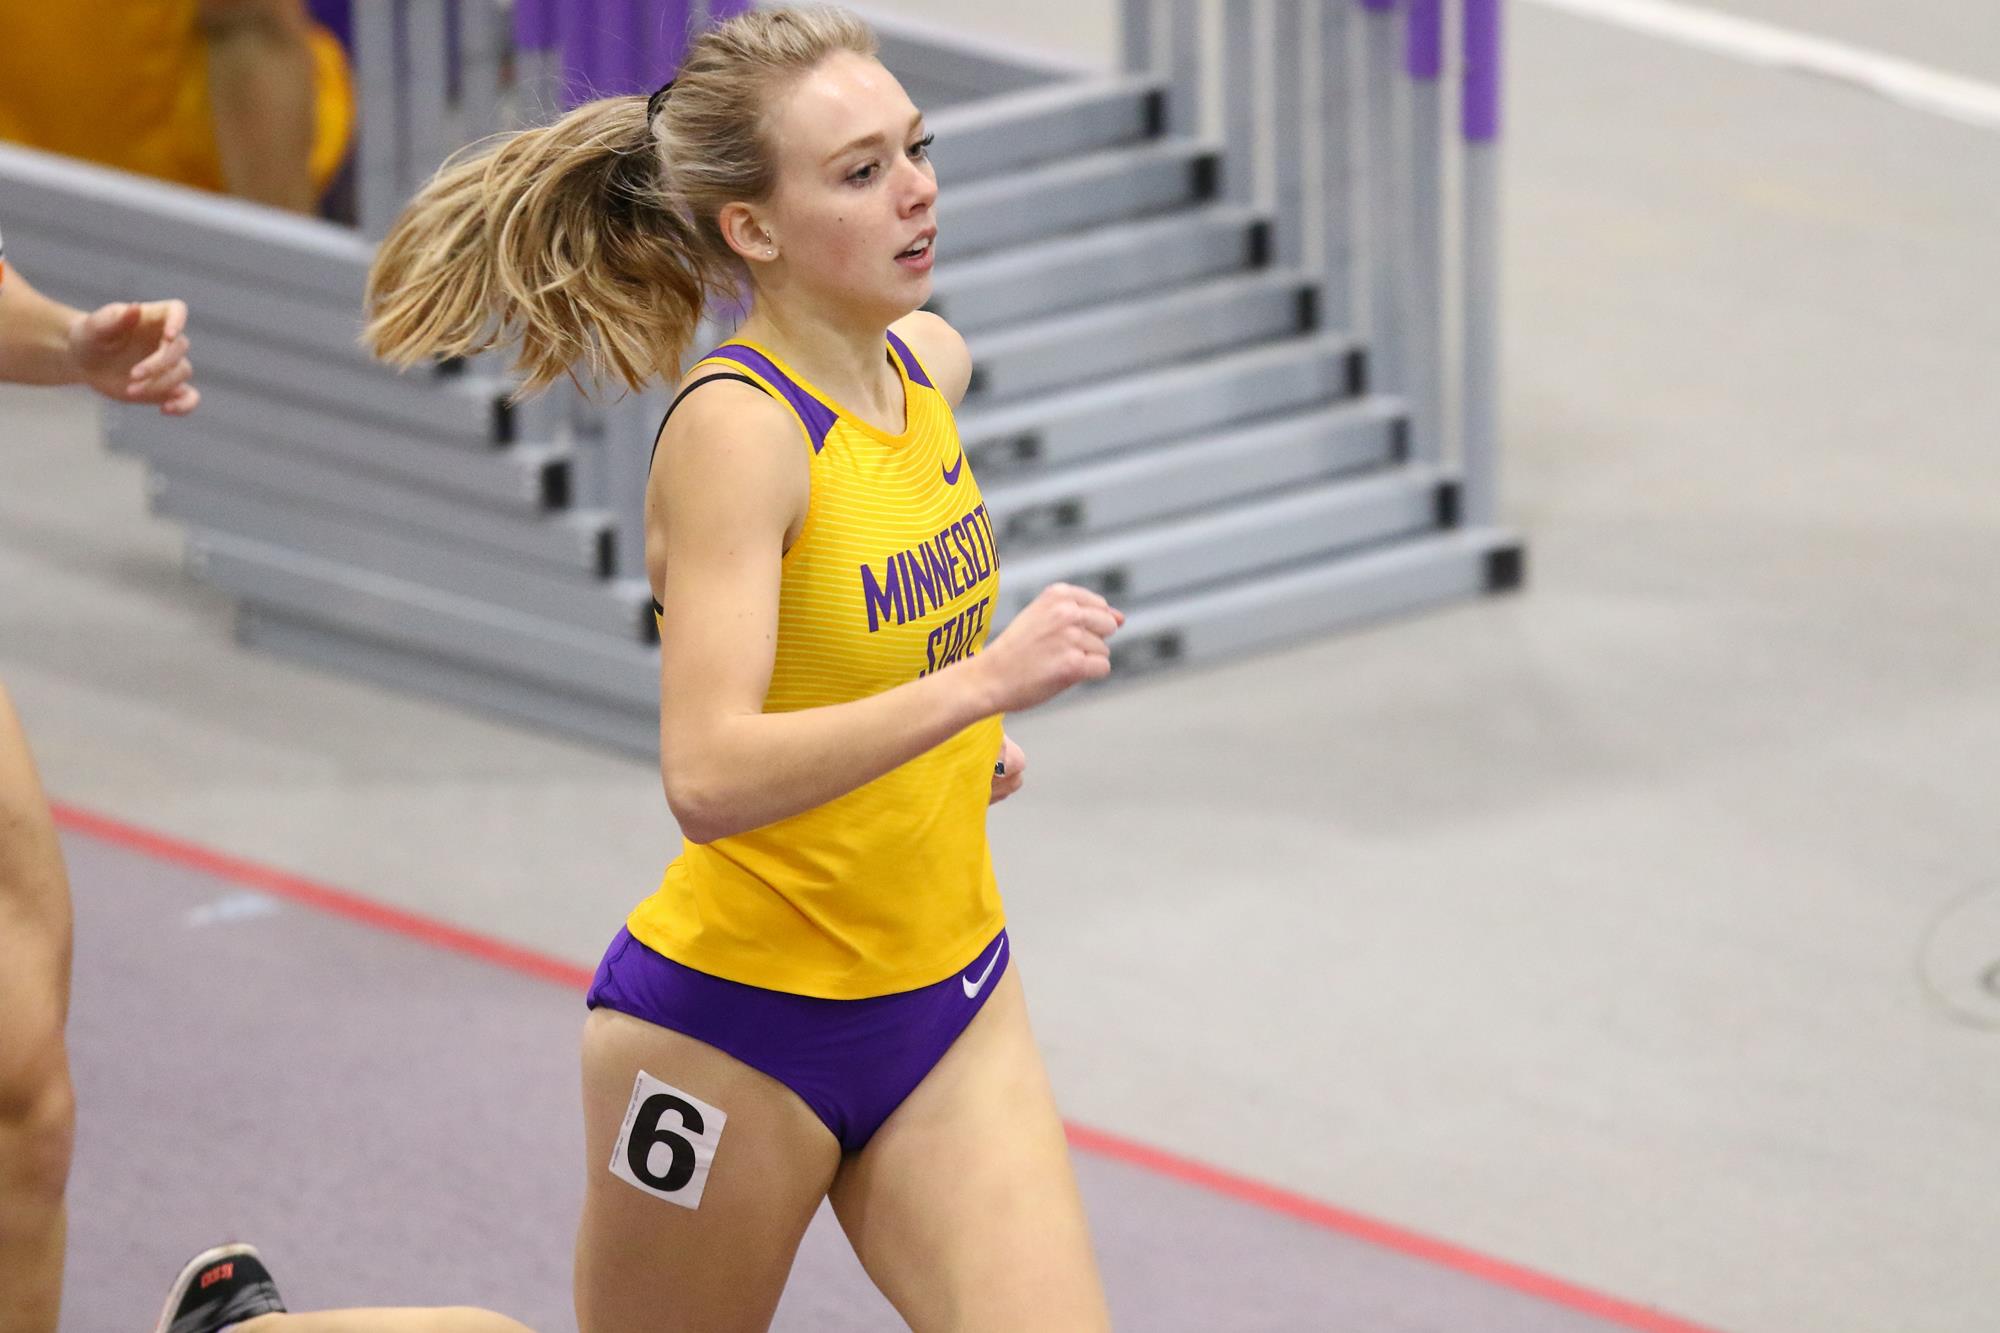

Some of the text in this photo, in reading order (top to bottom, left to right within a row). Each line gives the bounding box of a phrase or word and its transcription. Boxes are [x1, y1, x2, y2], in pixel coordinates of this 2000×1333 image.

[860, 501, 999, 633] MINNESOT
[919, 596, 990, 679] STATE
[627, 1093, 705, 1193] 6
